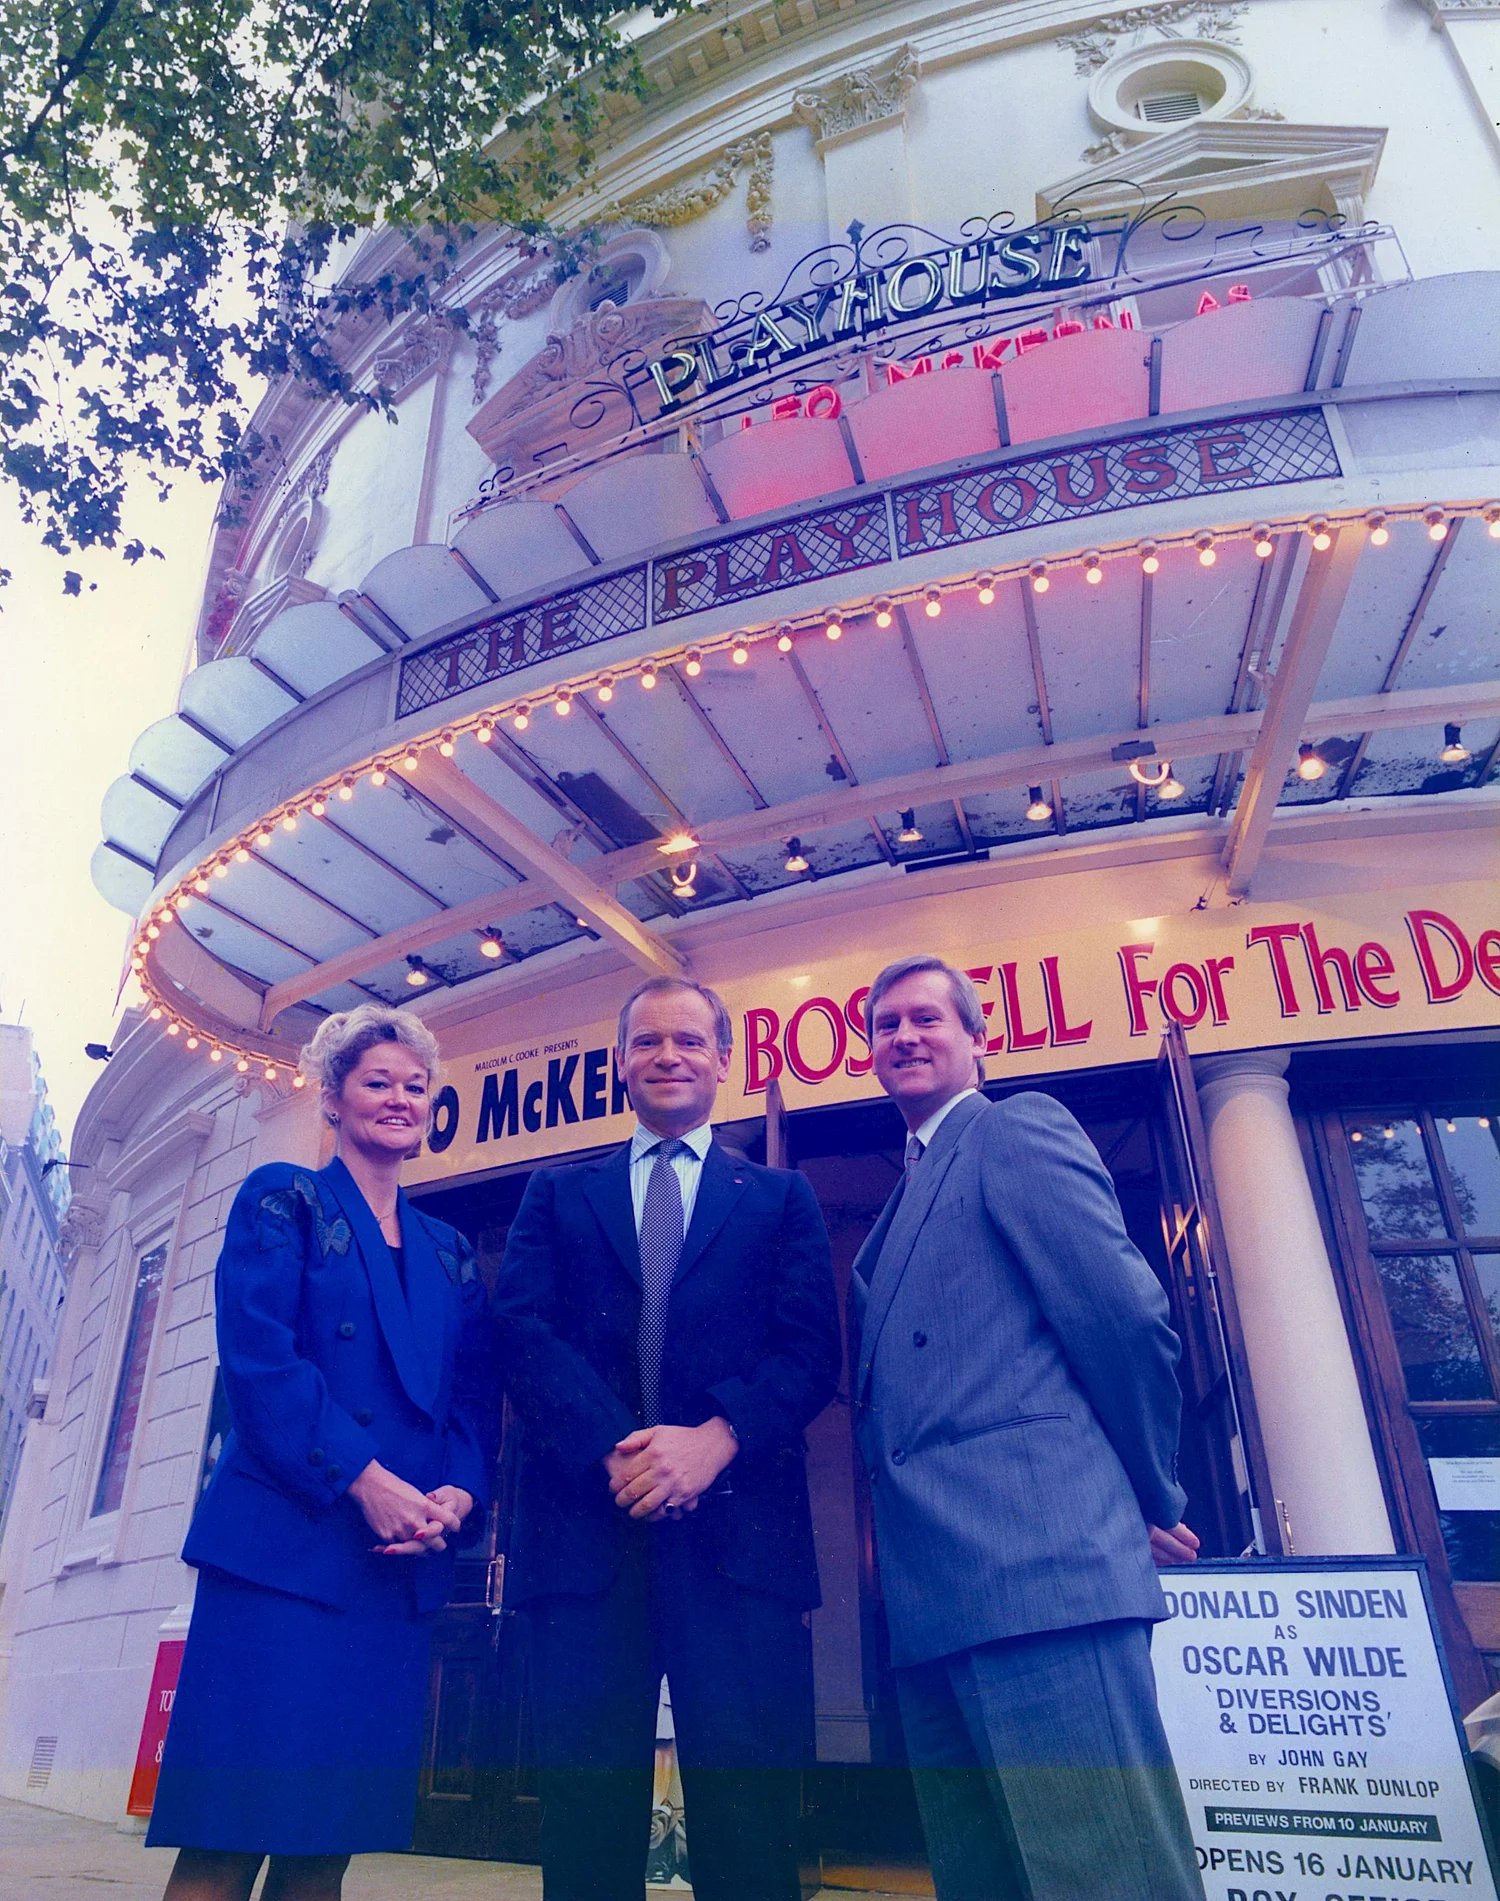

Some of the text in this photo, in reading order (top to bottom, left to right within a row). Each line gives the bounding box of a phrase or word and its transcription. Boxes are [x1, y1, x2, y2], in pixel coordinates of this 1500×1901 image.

[649, 221, 1092, 415] PLAYHOUSE
[434, 599, 580, 688] THE
[744, 956, 1093, 1096] BOSELL
[1120, 941, 1235, 1037] For
[1246, 921, 1400, 1017] The
[474, 1056, 508, 1073] MALCOLM
[515, 1048, 539, 1062] COOKE
[544, 1039, 579, 1055] PRESENTS
[1164, 1589, 1409, 1619] DONALD SINDEN
[1274, 1624, 1298, 1640] AS
[1182, 1645, 1408, 1678] OSCAR WILDE
[1219, 1712, 1237, 1734] &
[1249, 1749, 1369, 1769] BY JOHN GAY
[1189, 1776, 1440, 1799] DIRECTED BY FRANK DUNLOP
[1215, 1812, 1428, 1835] PREVIEWS FROM 10 JANUARY
[1195, 1846, 1474, 1886] OPENS 16 JANUARY
